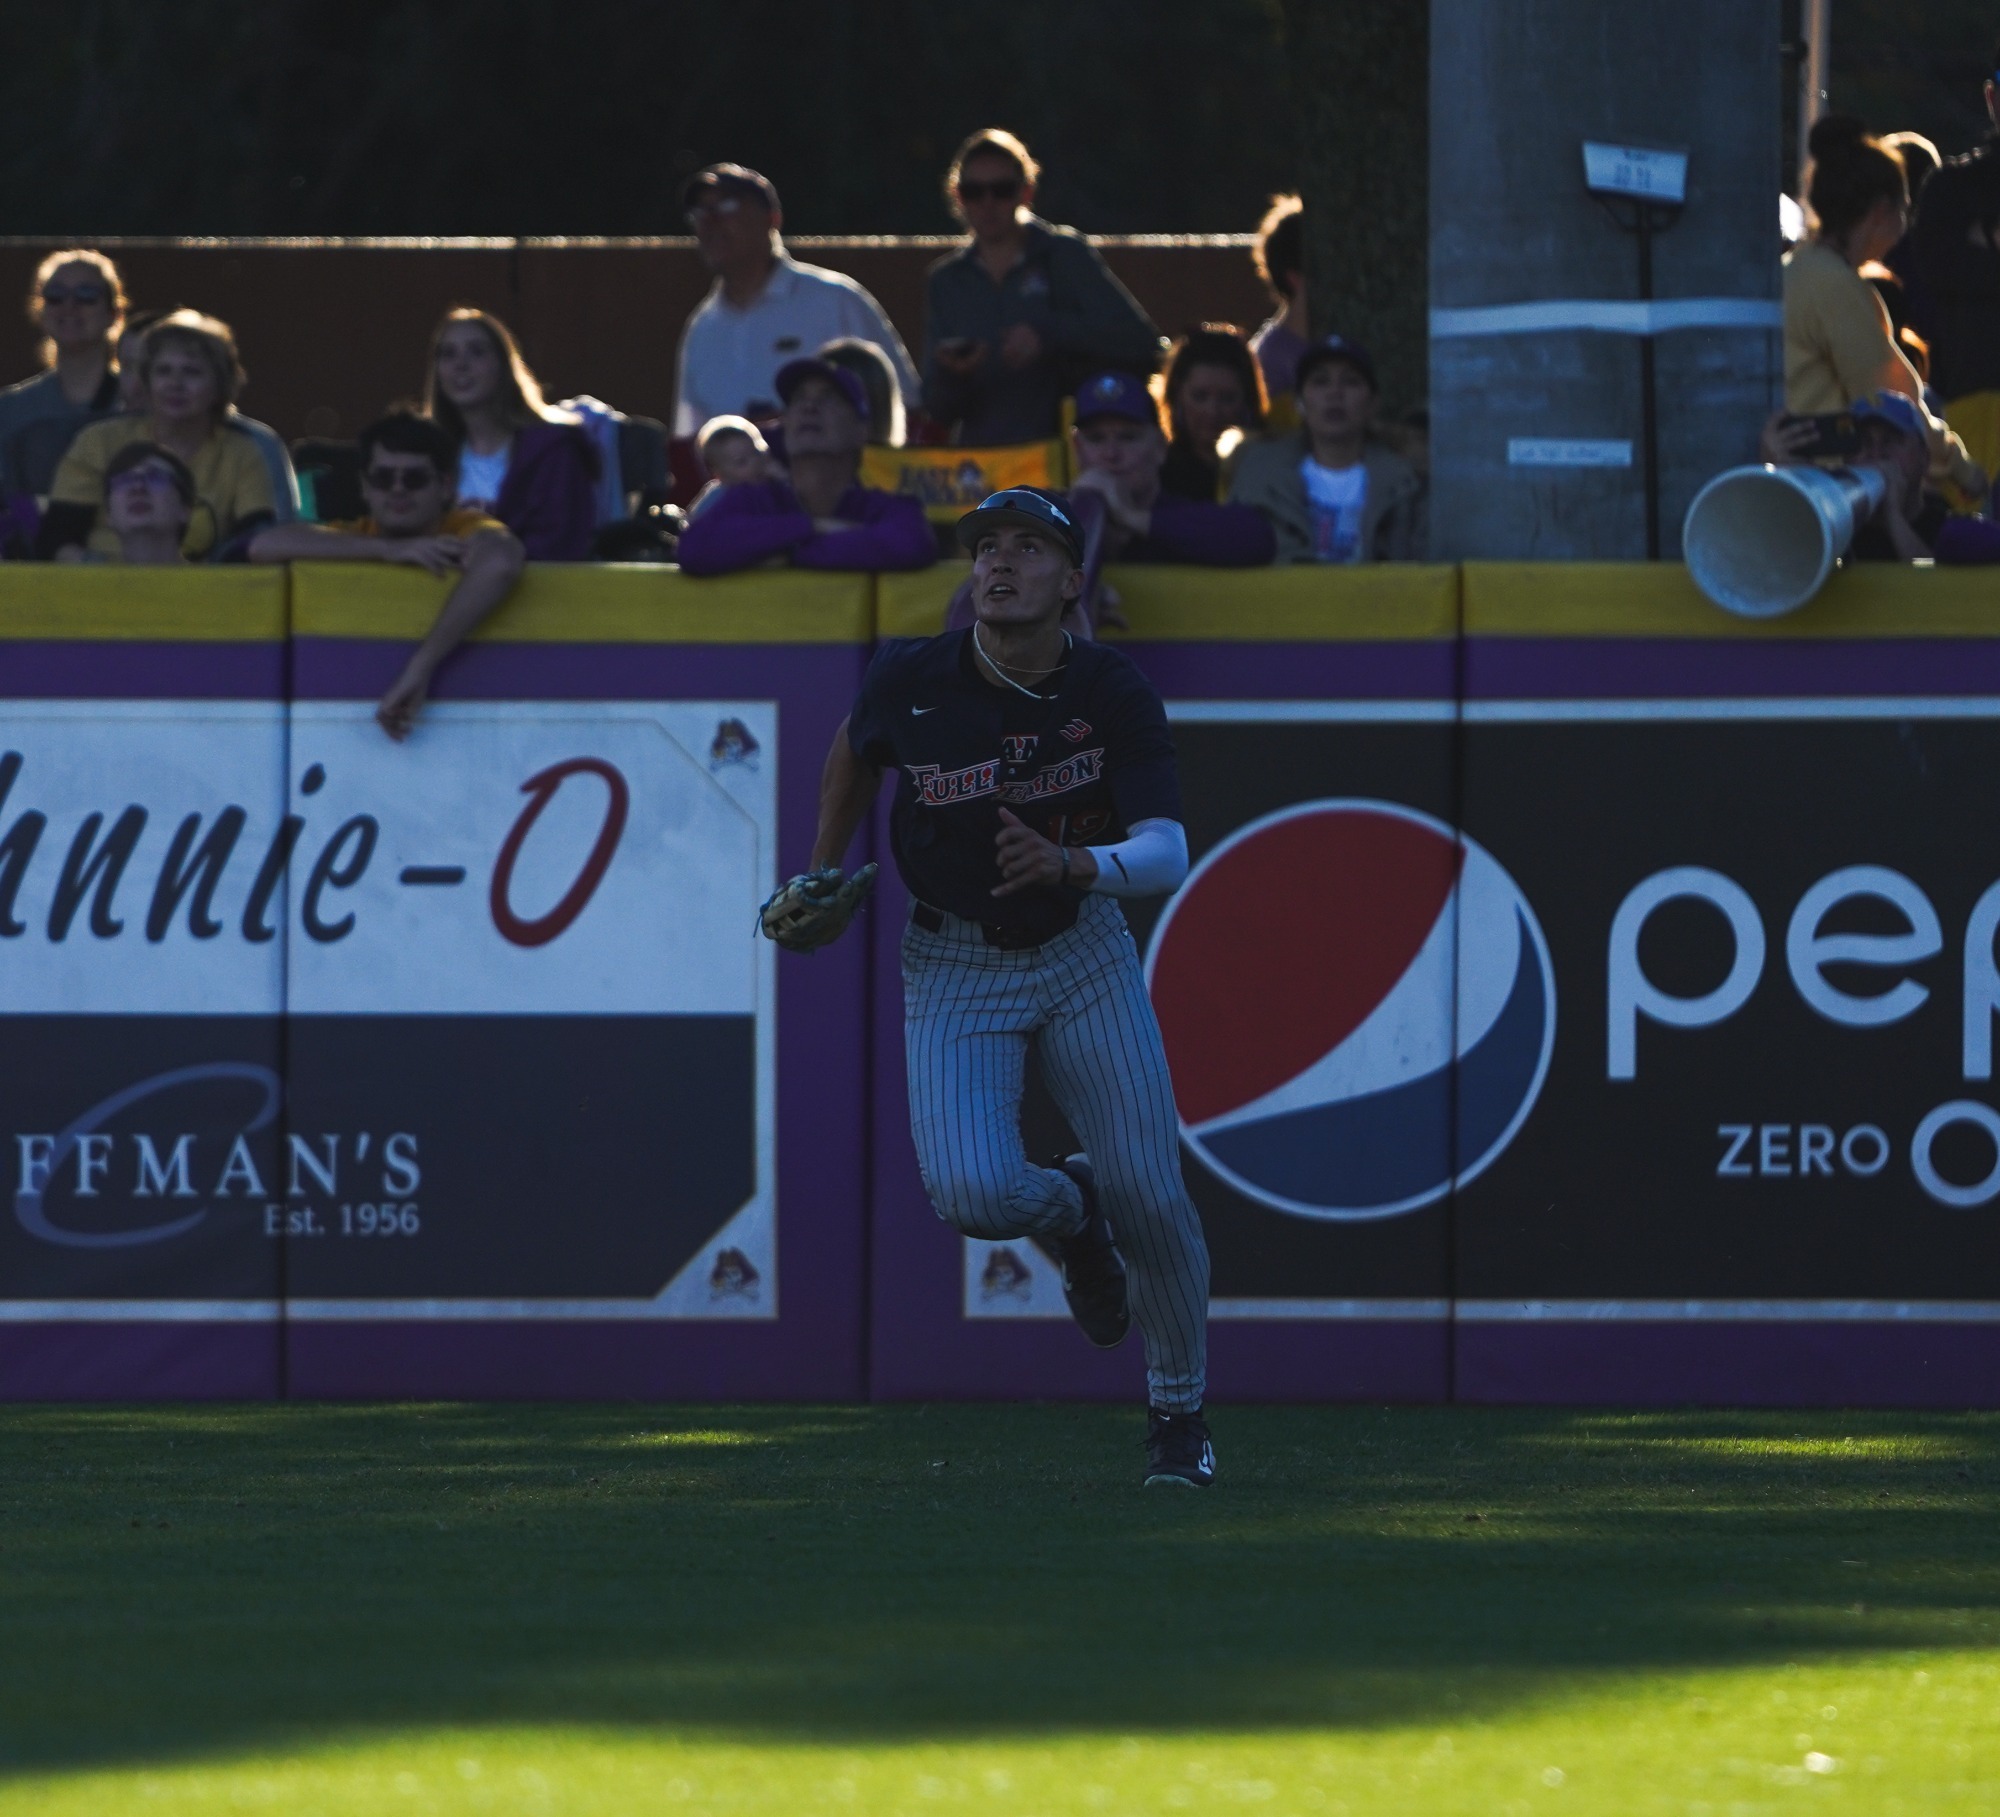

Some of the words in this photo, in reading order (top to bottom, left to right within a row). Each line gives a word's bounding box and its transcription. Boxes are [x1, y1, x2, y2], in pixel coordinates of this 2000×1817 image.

[906, 749, 1102, 804] FULLTON
[14, 1132, 423, 1199] FFMAN'S
[1716, 1123, 1891, 1177] ZERO
[264, 1203, 325, 1235] Est.
[340, 1203, 421, 1235] 1956
